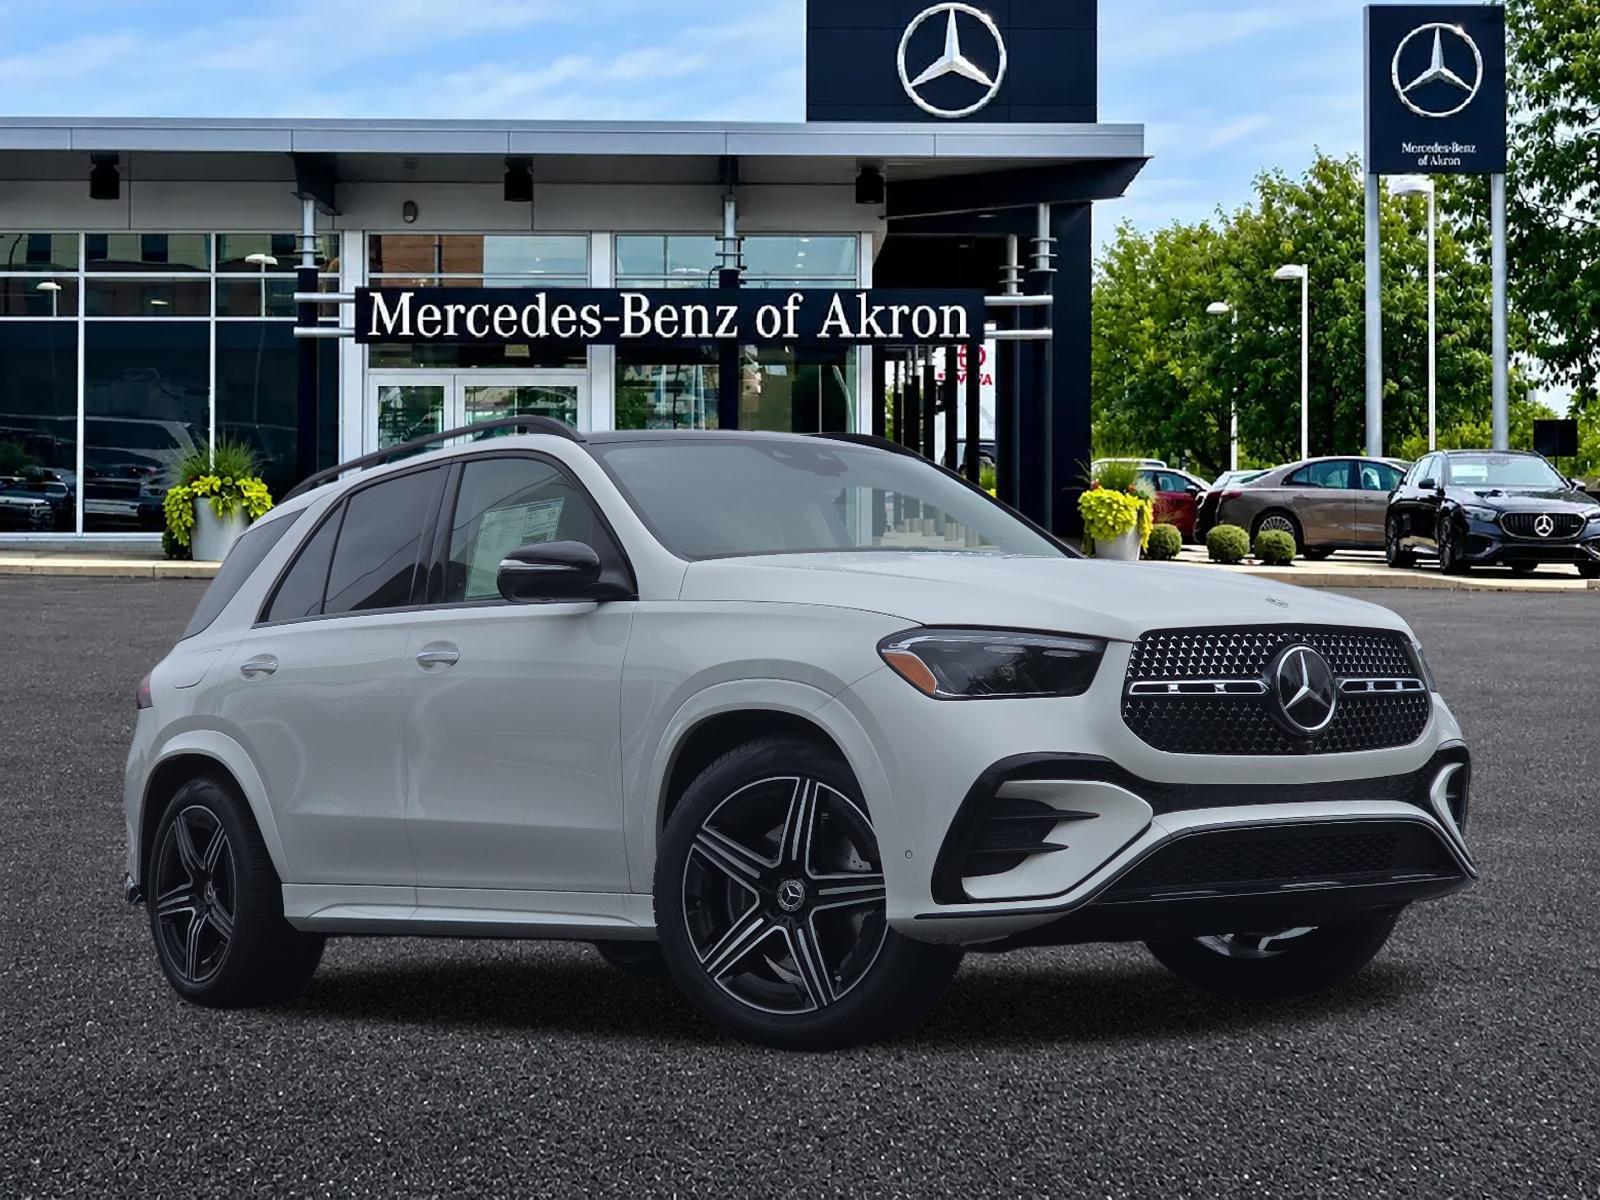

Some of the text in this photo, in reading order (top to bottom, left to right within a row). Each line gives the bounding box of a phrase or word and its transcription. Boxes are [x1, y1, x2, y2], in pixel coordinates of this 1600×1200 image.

[1401, 141, 1476, 153] Mercedes-Benz
[1418, 155, 1461, 165] of Akron
[367, 292, 971, 338] Mercedes-Benz of Akron
